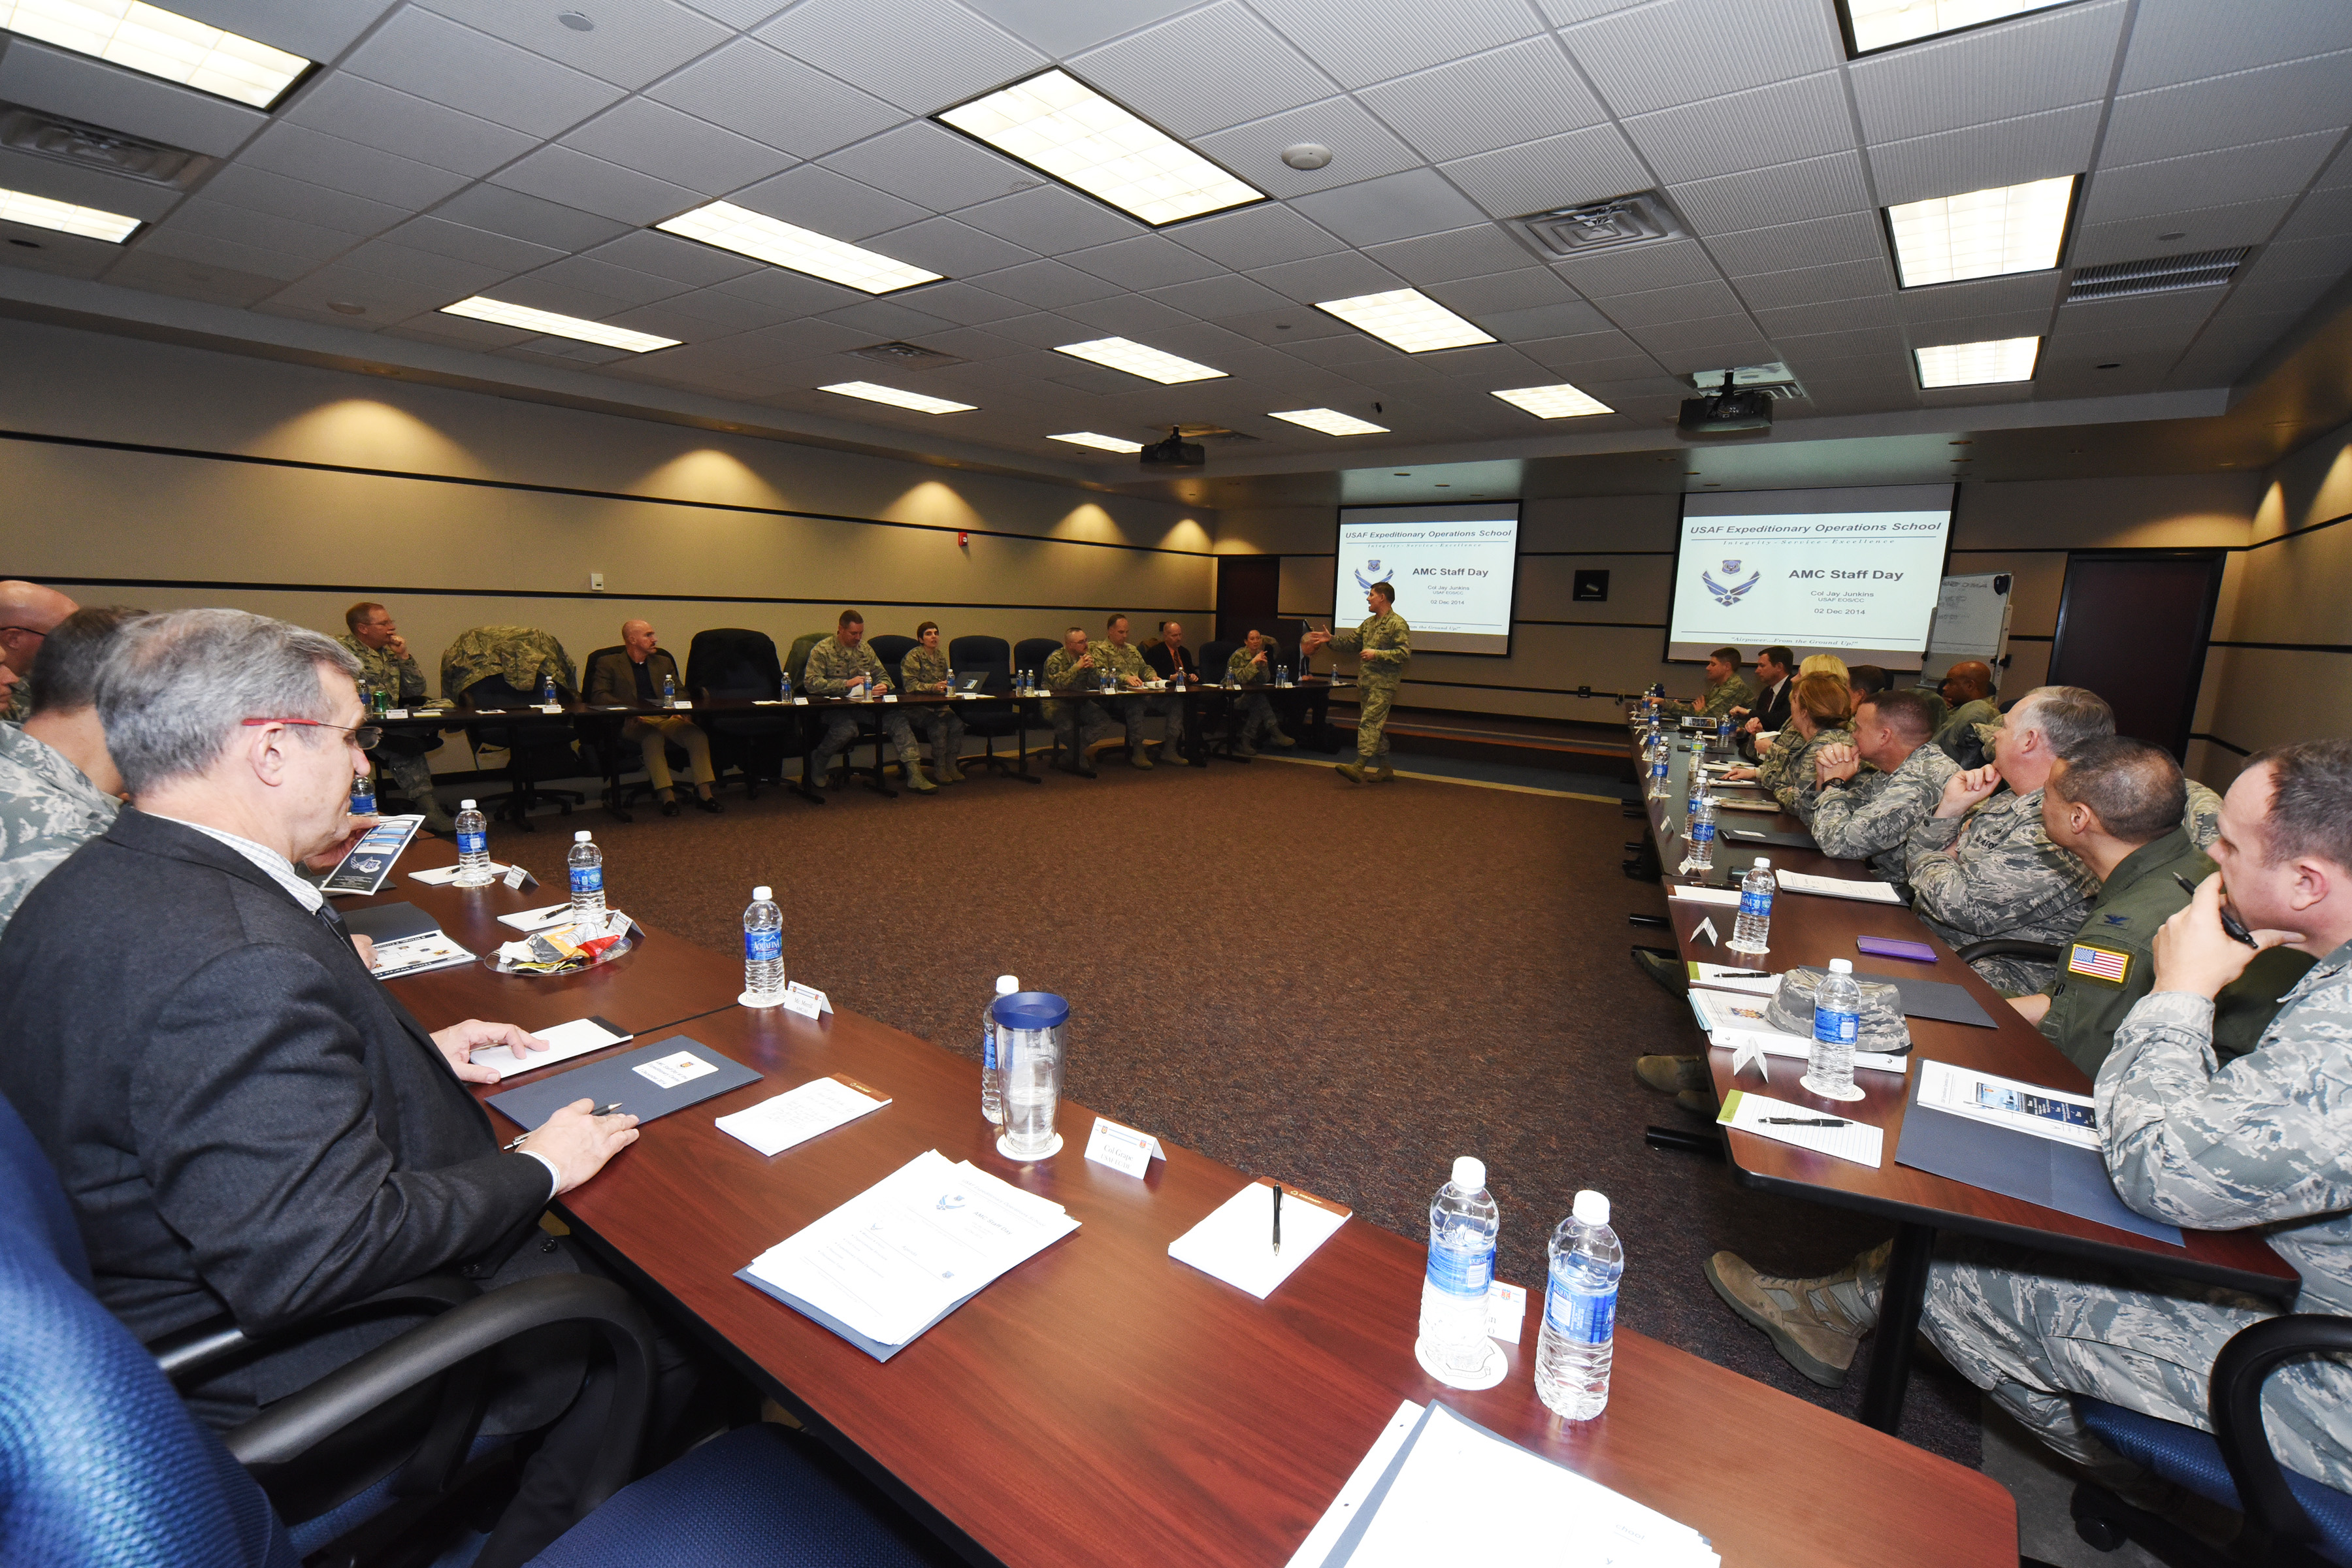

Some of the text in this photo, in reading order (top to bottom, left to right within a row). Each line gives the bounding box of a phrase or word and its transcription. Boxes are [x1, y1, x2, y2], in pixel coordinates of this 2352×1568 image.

[1428, 530, 1475, 538] Operations
[1726, 525, 1810, 534] Expeditionary
[1815, 524, 1887, 532] Operations
[1892, 522, 1942, 531] School
[1467, 568, 1489, 578] Day
[1788, 570, 1904, 581] AMC Staff Day
[753, 939, 780, 951] AQUAFINA
[1103, 1144, 1134, 1161] Col Grape
[972, 1211, 988, 1220] AMC
[987, 1218, 1003, 1228] Staff
[1000, 1226, 1013, 1235] Day
[1616, 1524, 1645, 1541] chool
